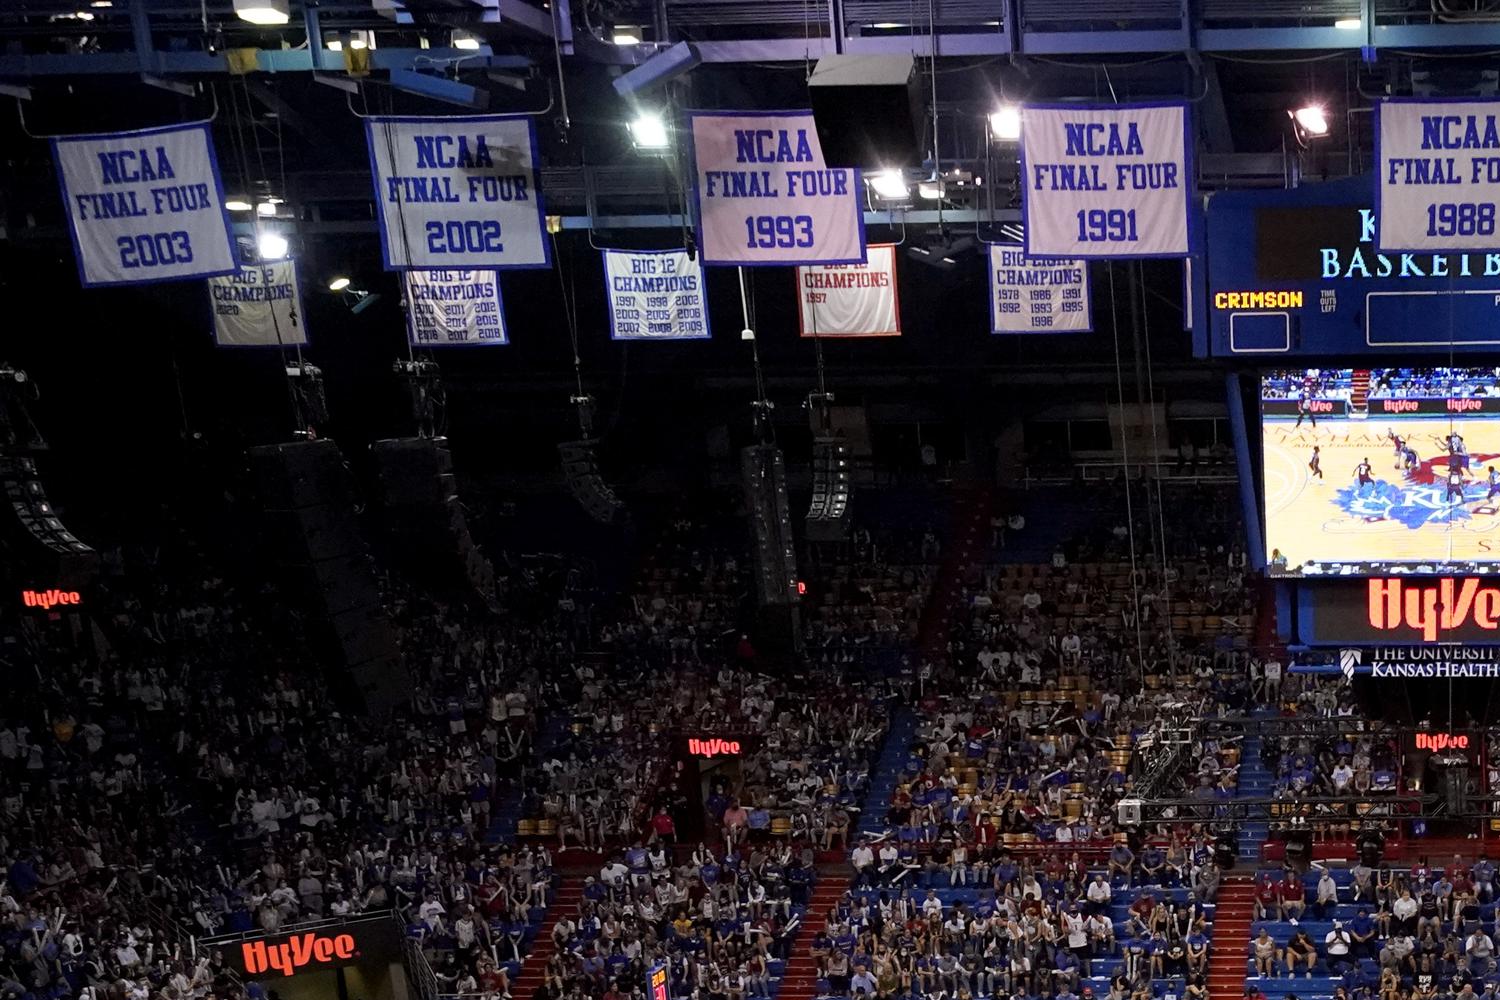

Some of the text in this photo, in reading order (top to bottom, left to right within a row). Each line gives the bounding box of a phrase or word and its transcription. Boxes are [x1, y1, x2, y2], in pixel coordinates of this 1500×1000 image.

[1065, 123, 1144, 156] NCAA
[1421, 116, 1500, 150] NCAA
[416, 135, 494, 168] NCAA
[736, 130, 813, 163] NCAA
[97, 147, 175, 184] NCAA
[1389, 158, 1462, 185] FINAL
[706, 168, 848, 198] FINAL FOUR
[1034, 162, 1178, 191] FINAL FOUR
[387, 174, 529, 203] FINAL FOUR
[76, 183, 210, 220] FINAL FOUR
[1076, 209, 1138, 242] 1991
[1426, 203, 1496, 237] 1988
[425, 220, 503, 254] 2002
[745, 216, 814, 248] 1993
[117, 231, 193, 269] 2003
[632, 258, 675, 274] BIG 12
[614, 275, 697, 292] CHAMPIONS
[804, 272, 889, 288] CHAMPIONS
[997, 269, 1082, 286] CHAMPIONS
[213, 284, 294, 301] CHAMPIONS
[411, 283, 494, 300] CHAMPIONS
[616, 296, 635, 307] 1997
[675, 295, 699, 306] 2002
[998, 289, 1020, 300] 1978
[1062, 289, 1082, 299] 1991
[1215, 291, 1303, 309] CRIMSON
[616, 308, 701, 320] 2003 2005 2006
[999, 303, 1020, 313] 1992
[1031, 303, 1053, 314] 1993
[1321, 305, 1336, 313] LEFT
[618, 322, 640, 333] 2007
[679, 321, 703, 332] 2009
[23, 590, 81, 609] HyVee
[1373, 647, 1406, 660] THE
[1371, 662, 1434, 678] KANSAS
[1435, 662, 1499, 677] HEALTH
[689, 738, 740, 758] HyVee
[1415, 733, 1469, 752] HyVee
[241, 933, 355, 976] HyVee
